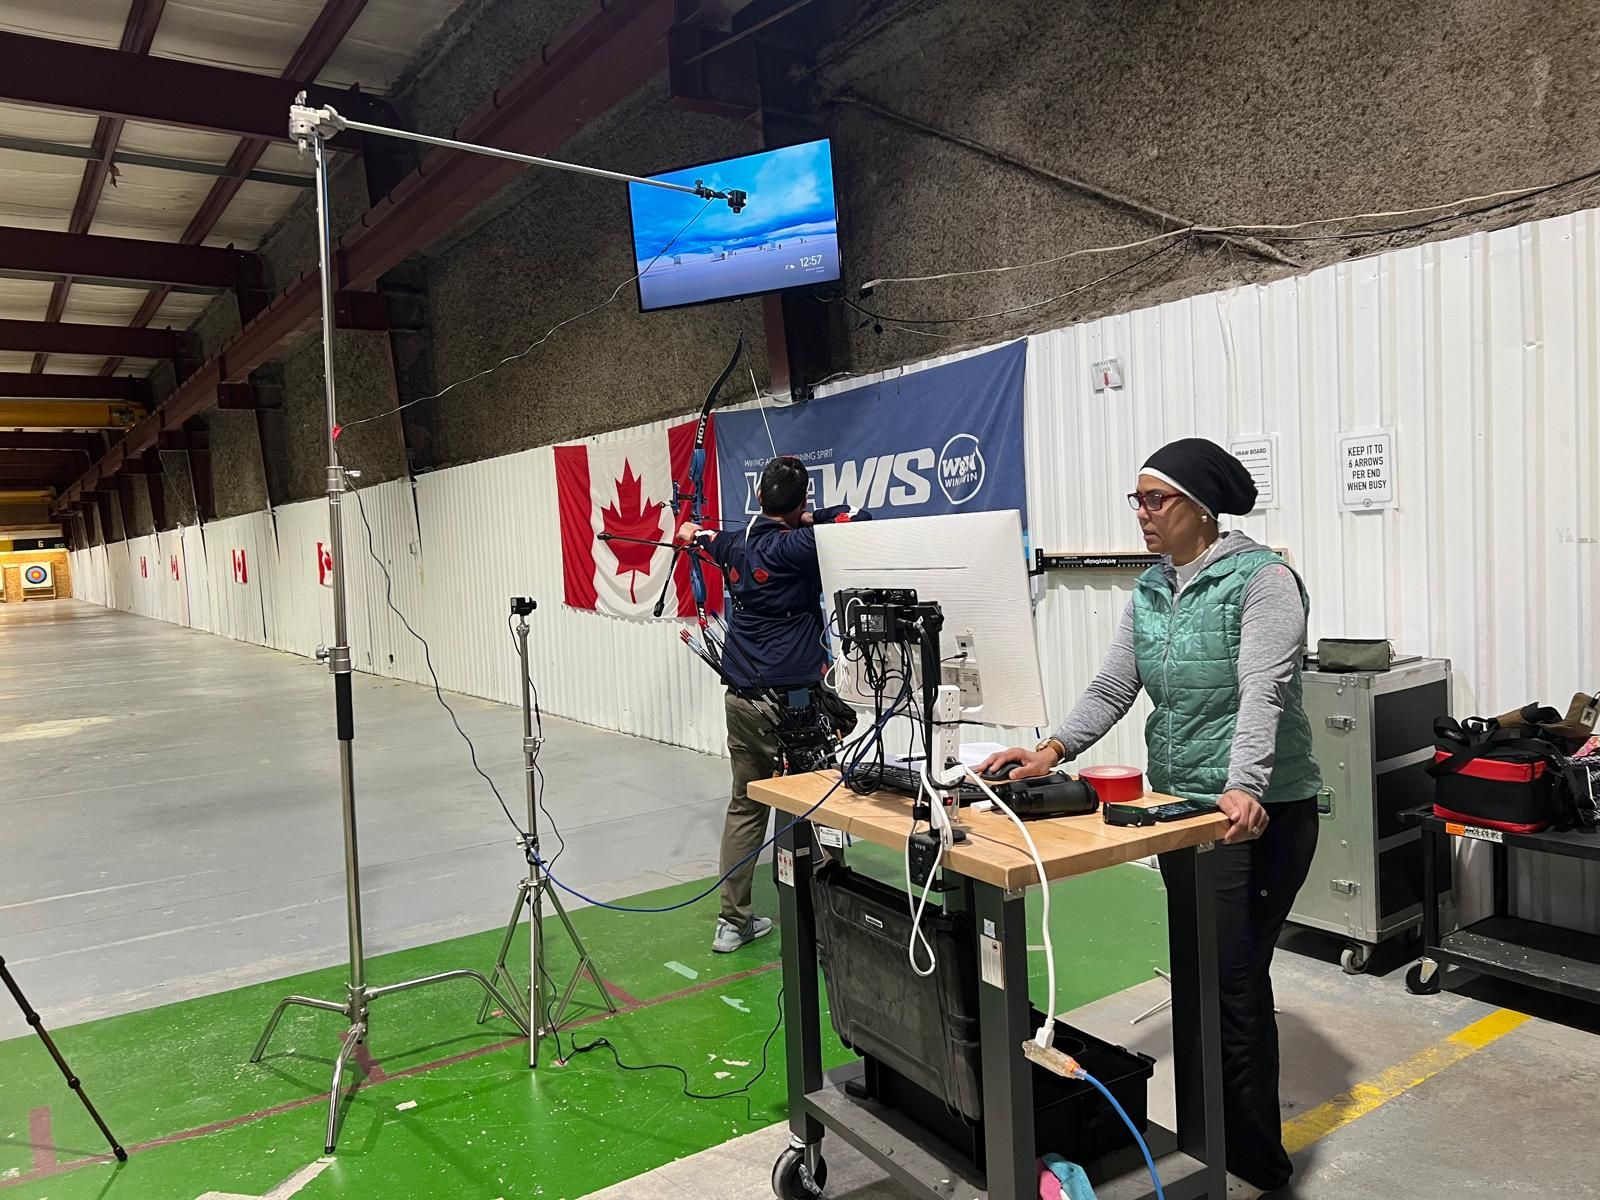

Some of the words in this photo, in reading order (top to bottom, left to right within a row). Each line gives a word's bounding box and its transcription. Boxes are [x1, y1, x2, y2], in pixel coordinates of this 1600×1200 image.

[799, 254, 823, 268] 12:57
[696, 412, 708, 445] HOYT
[816, 448, 833, 459] SPIRIT
[1348, 445, 1365, 457] KEEP
[1366, 444, 1373, 454] IT
[1374, 444, 1383, 454] TO
[1348, 459, 1353, 468] 6
[1354, 457, 1384, 468] ARROWS
[1352, 470, 1366, 480] PER
[1367, 469, 1381, 479] END
[1347, 482, 1367, 491] WHEN
[1368, 480, 1387, 490] BUSY
